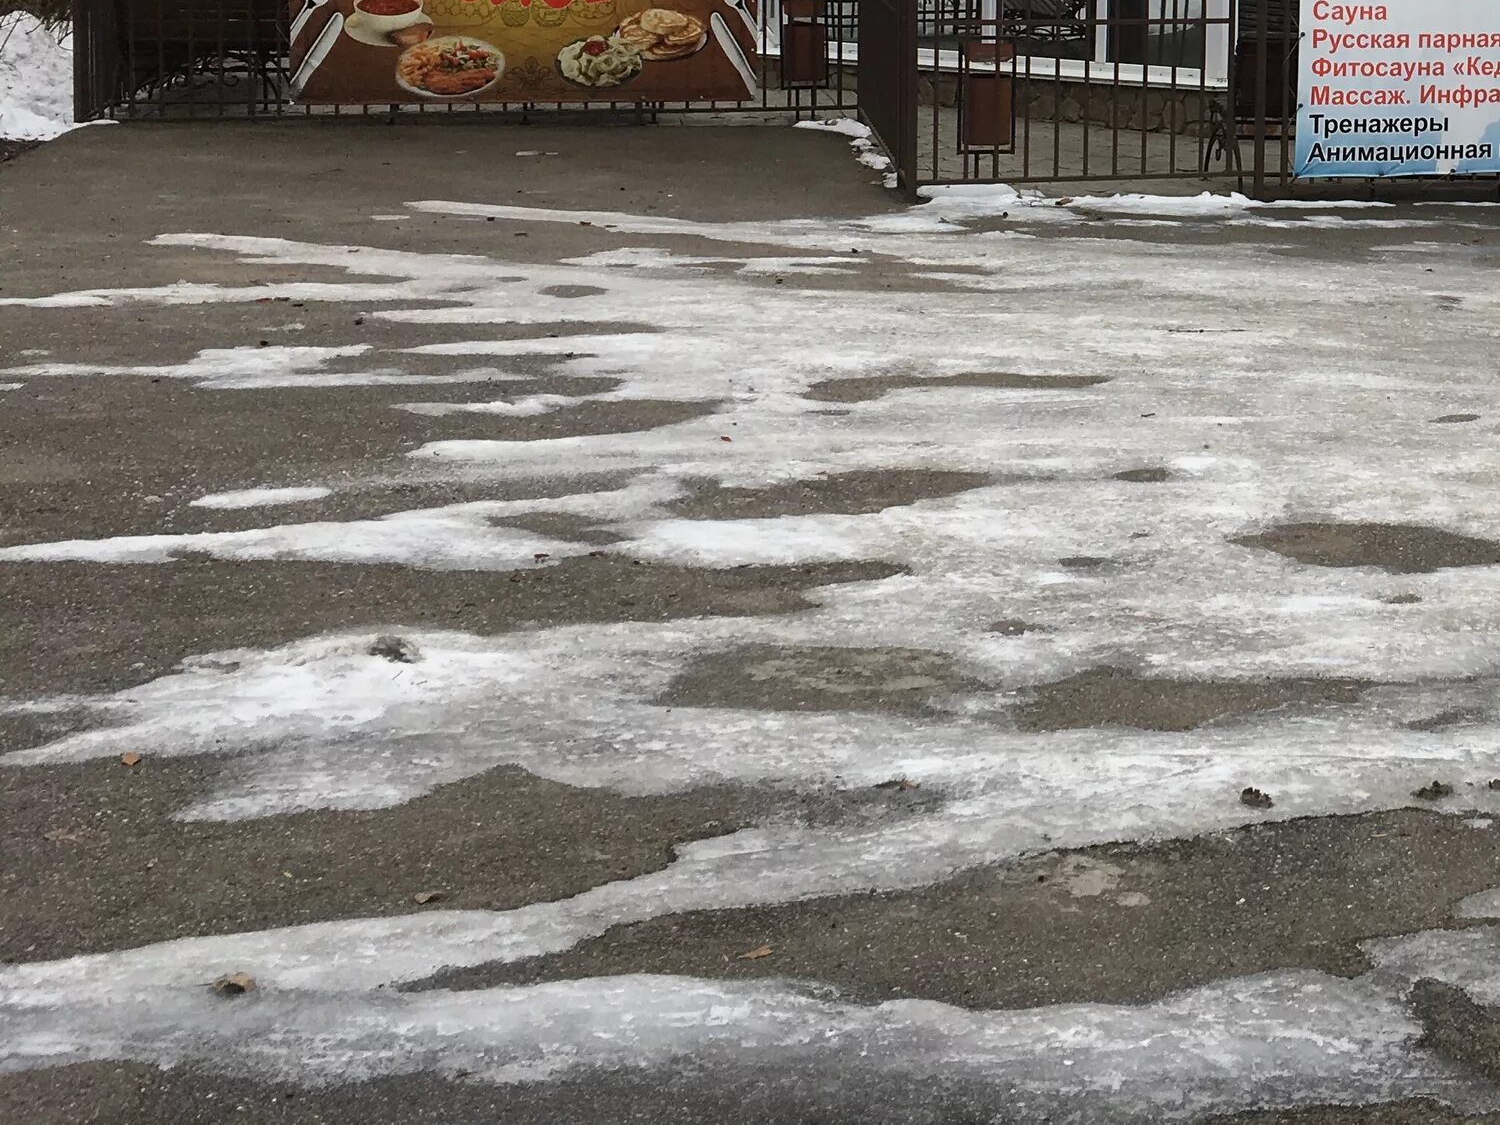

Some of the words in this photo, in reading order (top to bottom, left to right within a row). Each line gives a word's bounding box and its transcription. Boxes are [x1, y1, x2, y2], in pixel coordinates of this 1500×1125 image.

[1313, 0, 1387, 25] Сауна
[1312, 29, 1410, 53] Русская
[1311, 57, 1445, 82] Фитосауна
[1310, 85, 1411, 106] Массаж.
[1309, 114, 1449, 138] Тренажеры
[1308, 143, 1492, 163] Анимационная
